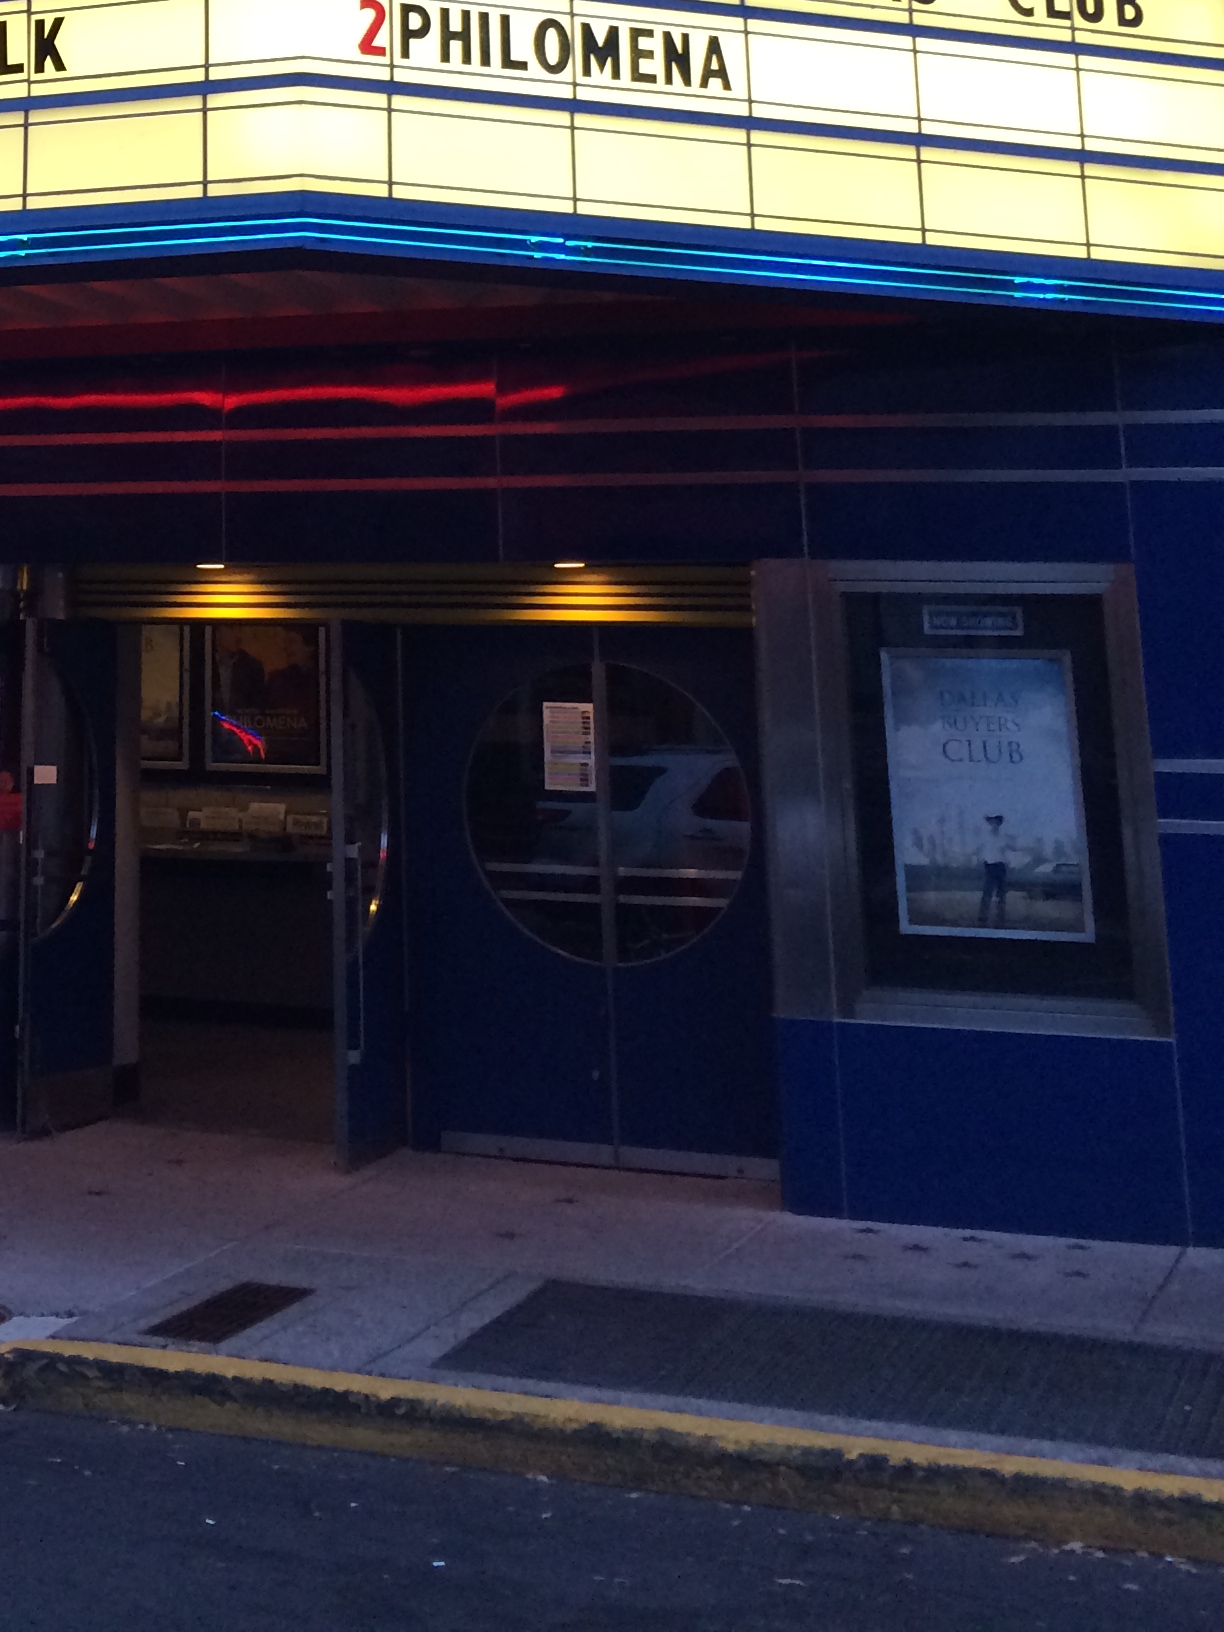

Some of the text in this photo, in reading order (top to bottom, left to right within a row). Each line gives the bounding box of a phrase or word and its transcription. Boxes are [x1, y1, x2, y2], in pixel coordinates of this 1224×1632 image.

[399, 3, 733, 92] PHILOMENA
[938, 689, 1020, 708] DALLAS
[225, 714, 309, 730] HILOMENA
[942, 714, 1022, 733] BUYERS
[941, 738, 1024, 764] CLUB
